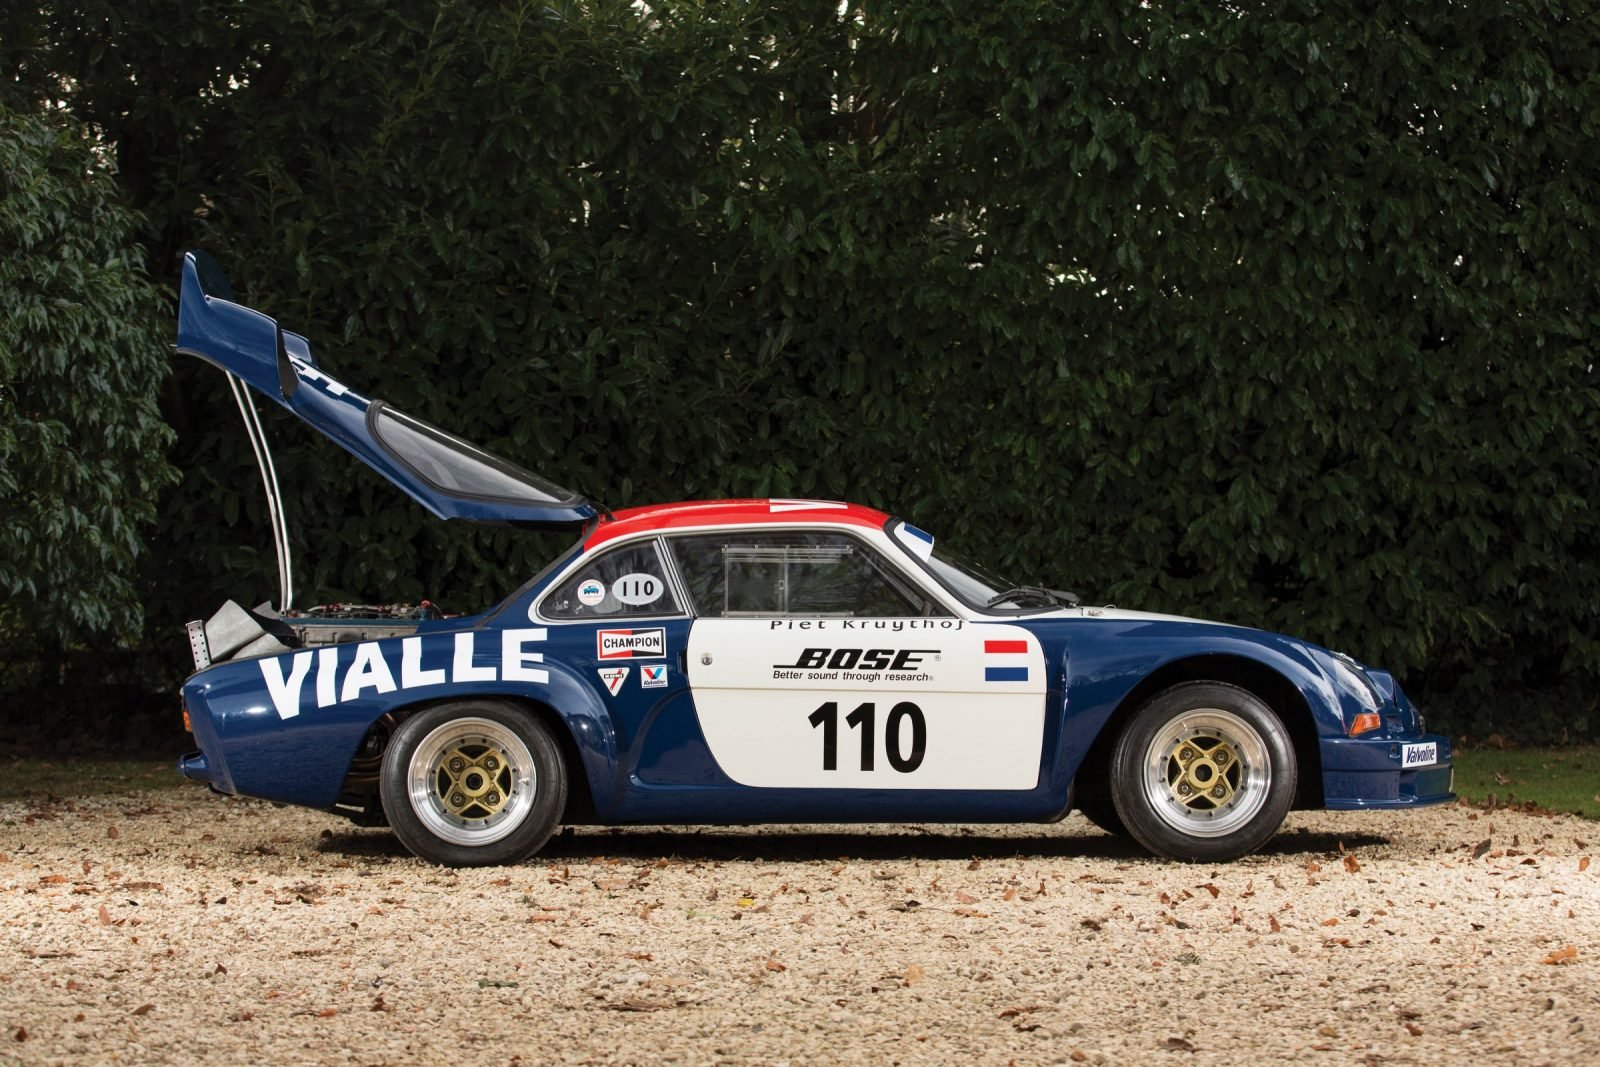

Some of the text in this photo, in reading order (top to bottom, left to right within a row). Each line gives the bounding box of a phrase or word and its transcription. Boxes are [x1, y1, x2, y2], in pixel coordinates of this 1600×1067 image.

[623, 580, 654, 596] 110
[770, 620, 826, 630] Piet
[603, 637, 660, 648] CHAMPION
[773, 648, 941, 671] BOSE
[258, 628, 549, 720] VIALLE
[773, 670, 803, 680] Better
[808, 671, 838, 681] sound
[842, 671, 881, 683] through
[808, 701, 927, 773] 110
[1406, 746, 1435, 763] Valvoline
